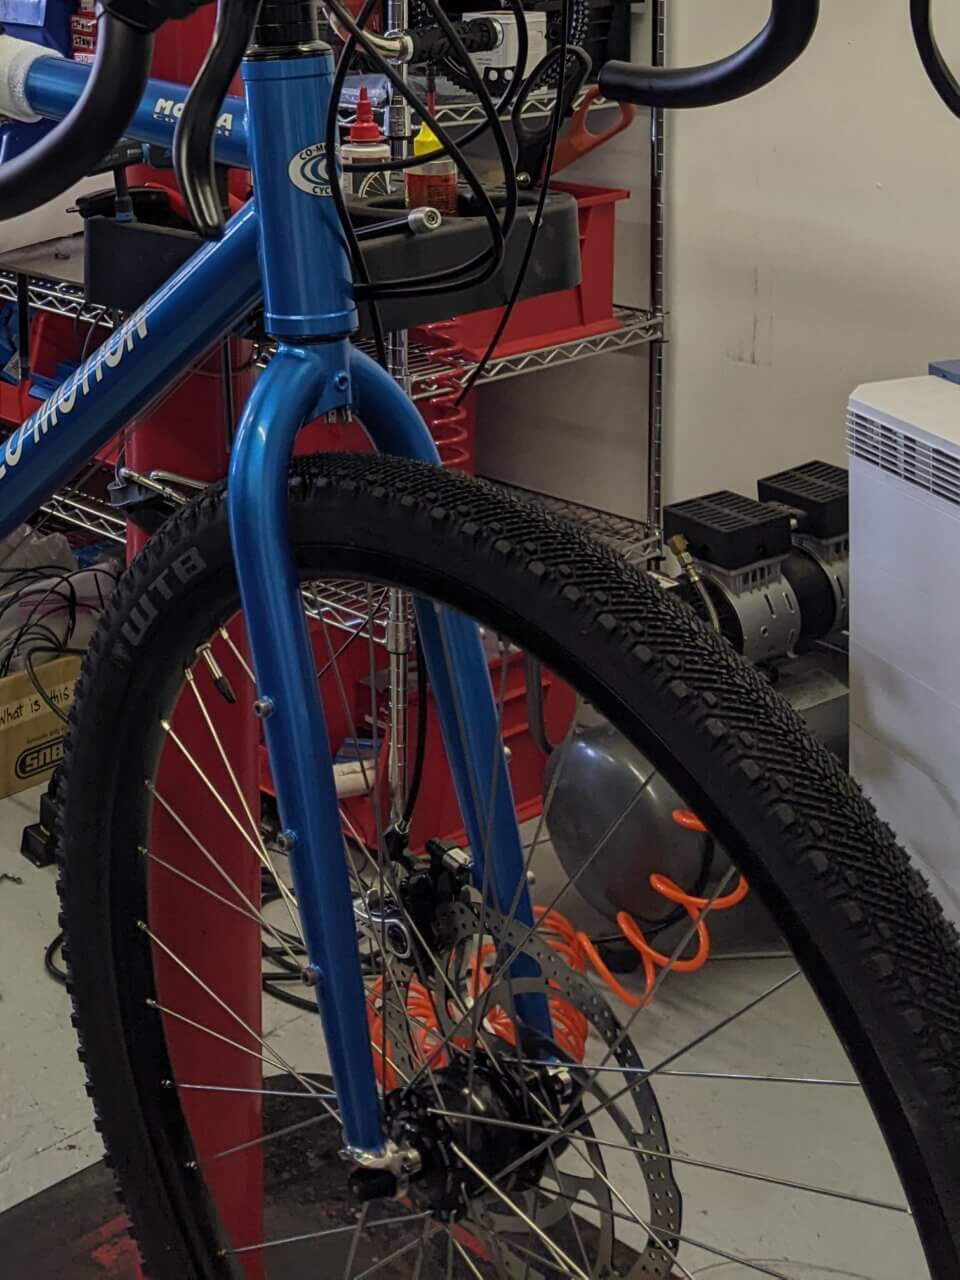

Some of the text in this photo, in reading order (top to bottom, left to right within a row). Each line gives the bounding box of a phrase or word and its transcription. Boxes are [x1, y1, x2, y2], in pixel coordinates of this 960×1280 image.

[121, 546, 207, 646] WTB
[30, 698, 41, 713] is
[50, 686, 70, 705] this
